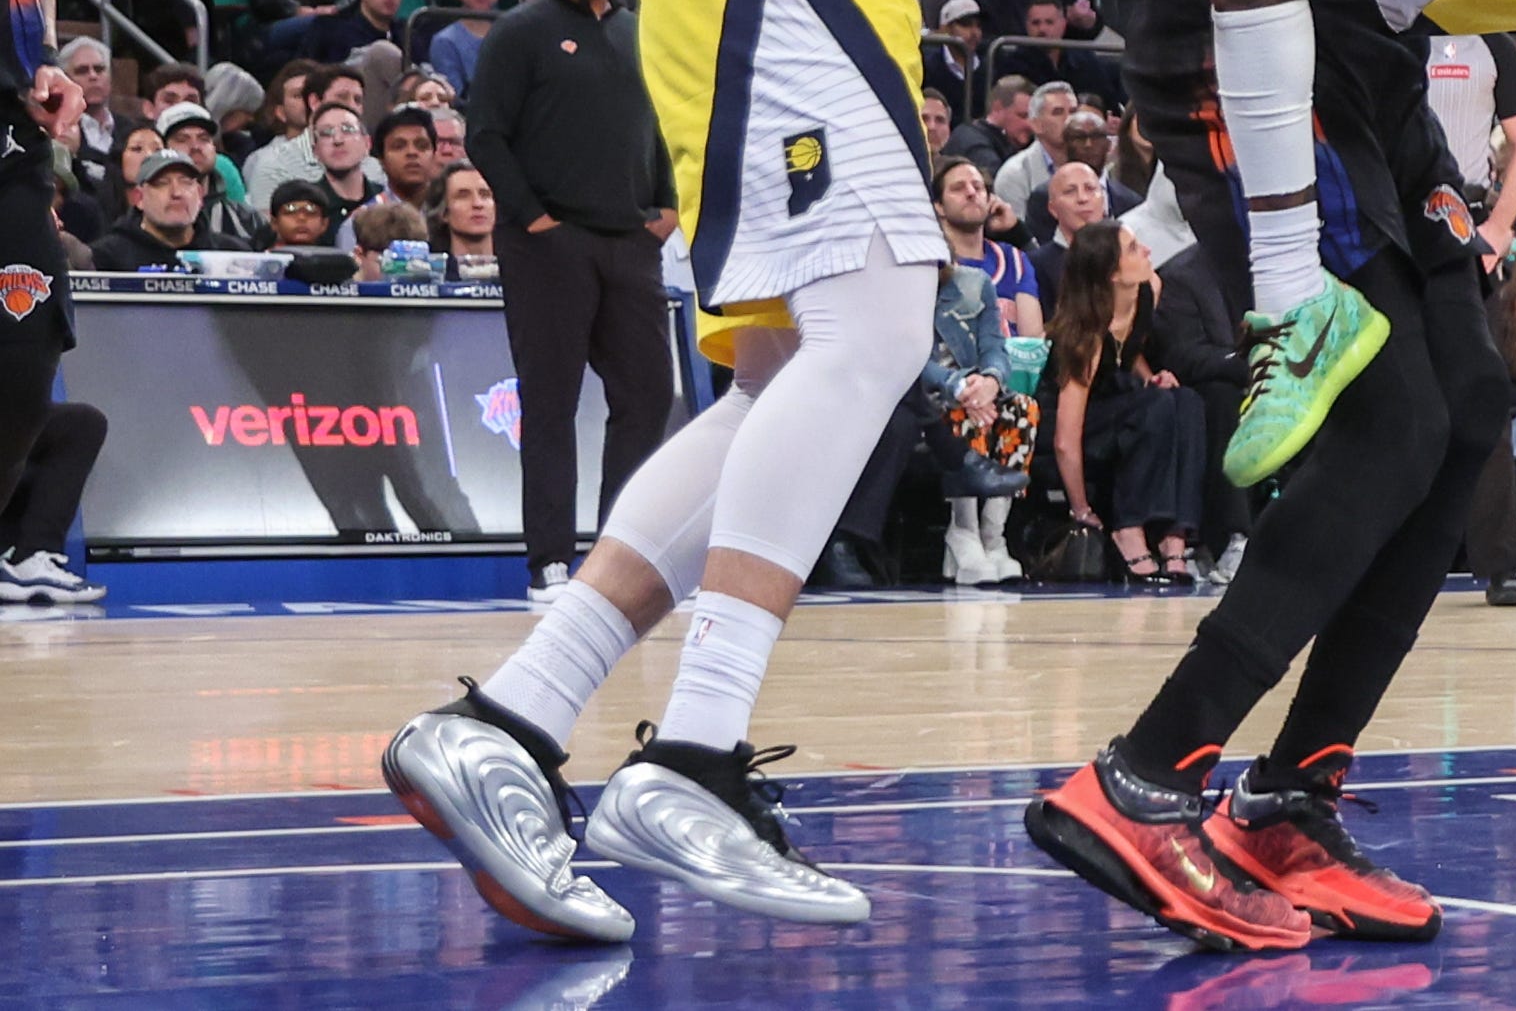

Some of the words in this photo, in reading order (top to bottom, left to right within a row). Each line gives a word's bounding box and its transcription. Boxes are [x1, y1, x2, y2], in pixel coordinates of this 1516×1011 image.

[69, 278, 111, 291] HASE
[144, 279, 195, 292] CHASE
[227, 280, 278, 294] CHASE
[310, 283, 360, 296] CHASE
[390, 283, 440, 297] CHASE
[189, 392, 420, 447] verizon
[365, 532, 453, 543] DAKTRONICS
